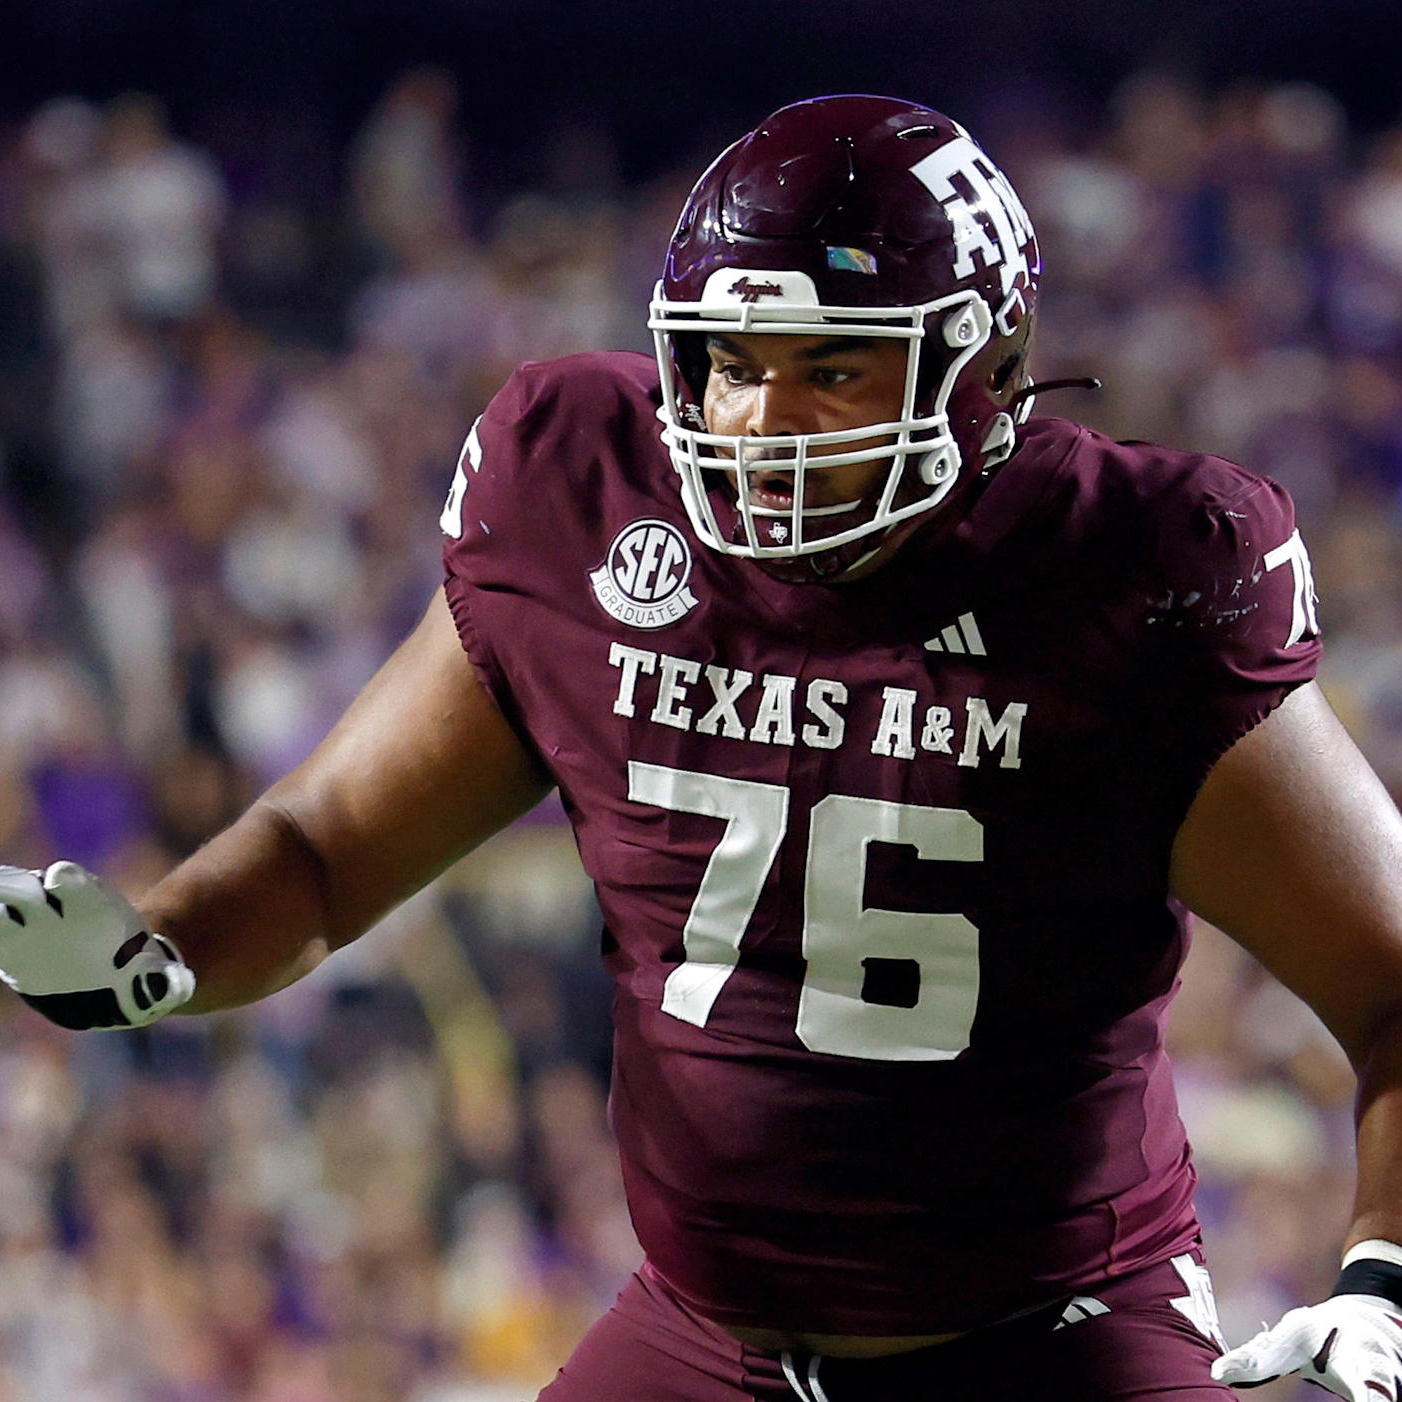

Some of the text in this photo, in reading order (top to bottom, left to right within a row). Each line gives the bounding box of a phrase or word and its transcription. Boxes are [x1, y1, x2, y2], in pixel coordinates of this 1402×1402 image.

[599, 584, 679, 625] GRADUATE
[615, 527, 684, 600] SEC
[608, 641, 1029, 769] TEXAS A&M
[627, 760, 985, 1062] 76
